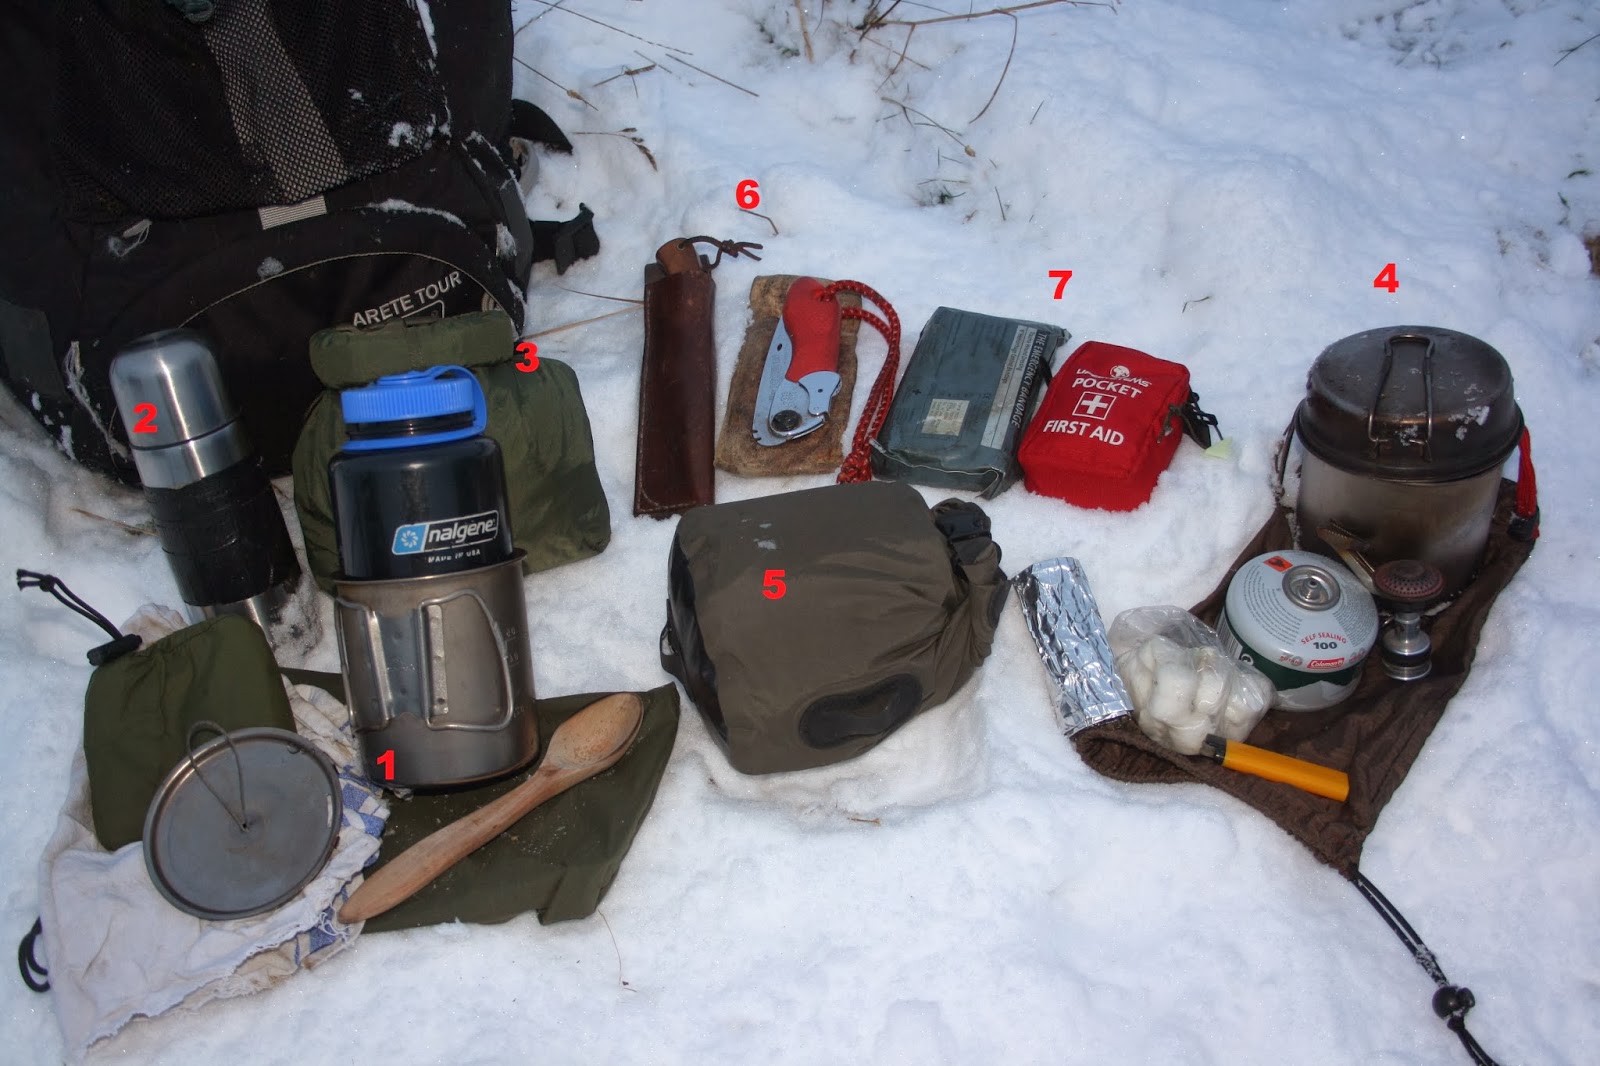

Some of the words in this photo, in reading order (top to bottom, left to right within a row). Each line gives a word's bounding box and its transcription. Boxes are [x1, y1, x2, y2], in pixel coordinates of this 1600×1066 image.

[353, 294, 414, 326] ARETE
[414, 271, 462, 304] TOUR
[1036, 333, 1047, 346] THE
[1024, 345, 1043, 386] EMERGENCY
[1072, 378, 1142, 398] POCKET
[1011, 387, 1030, 428] BANDAGE
[1043, 420, 1090, 436] FIRST
[1089, 426, 1124, 446] AID
[428, 519, 496, 543] nalgene
[467, 549, 480, 557] USA
[1301, 633, 1317, 645] SELF
[1318, 632, 1347, 644] SEALING
[1313, 642, 1338, 650] 100
[1310, 659, 1338, 668] Coleman
